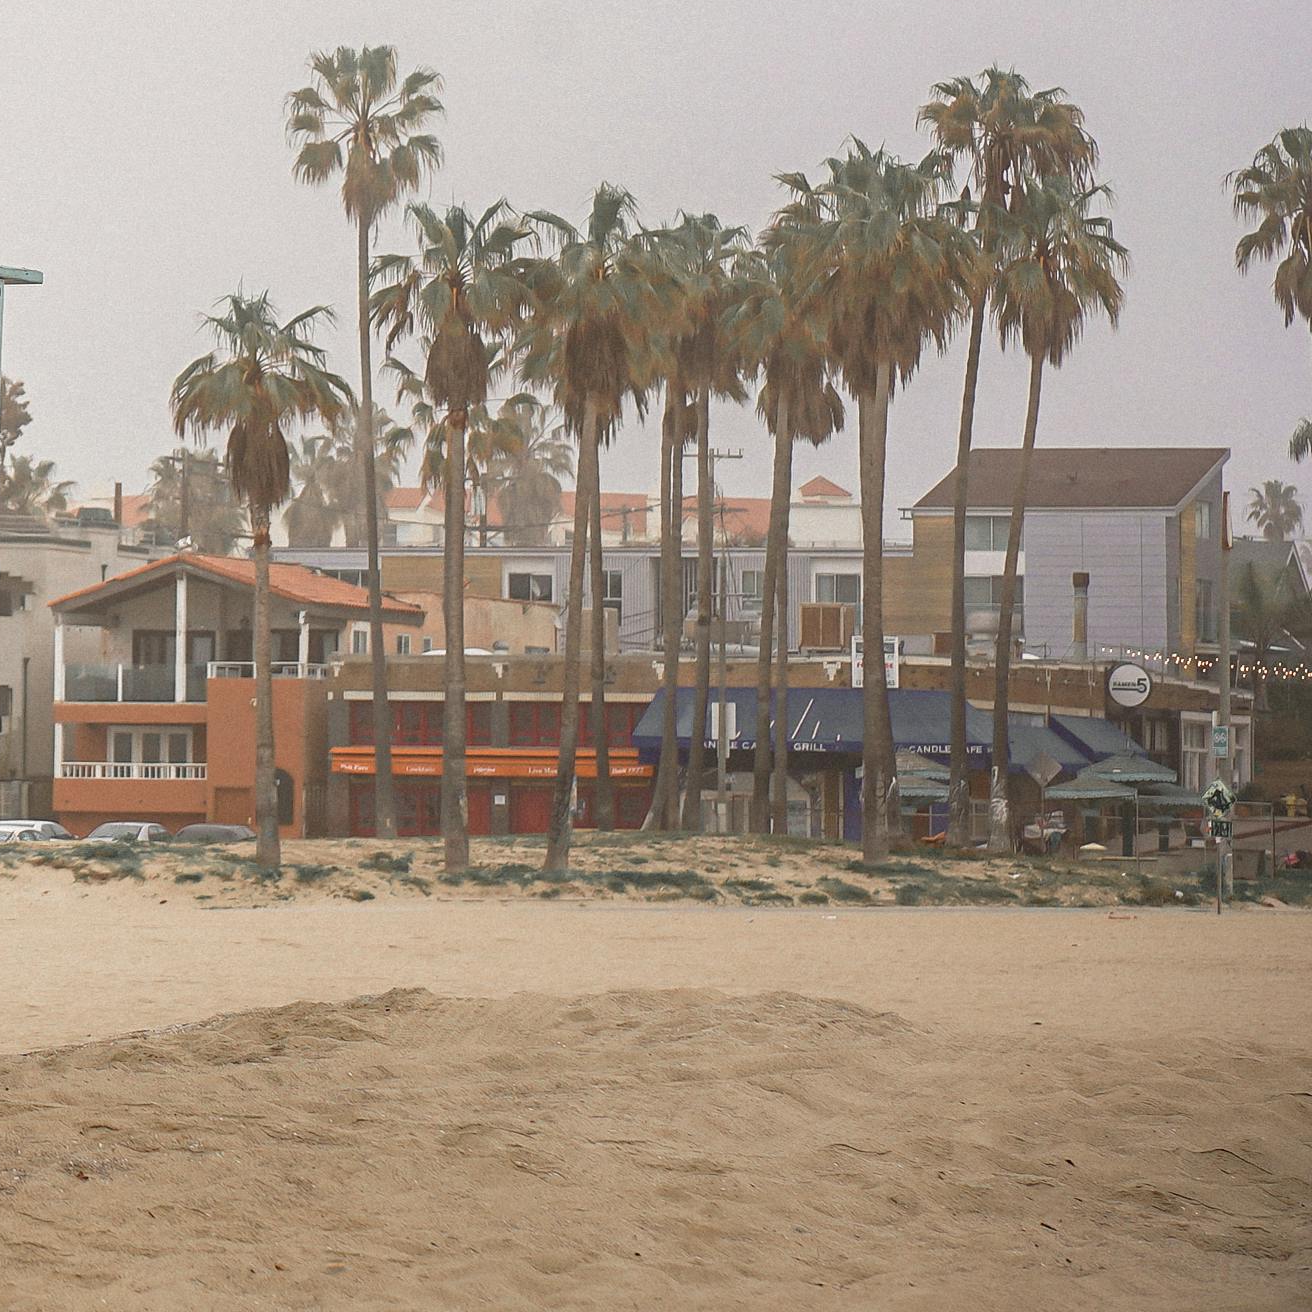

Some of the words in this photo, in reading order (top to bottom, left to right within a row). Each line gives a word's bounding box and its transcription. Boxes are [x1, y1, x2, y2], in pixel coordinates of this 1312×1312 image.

[1137, 677, 1147, 693] 5
[793, 742, 826, 752] GRILL
[908, 744, 952, 753] CANDLE
